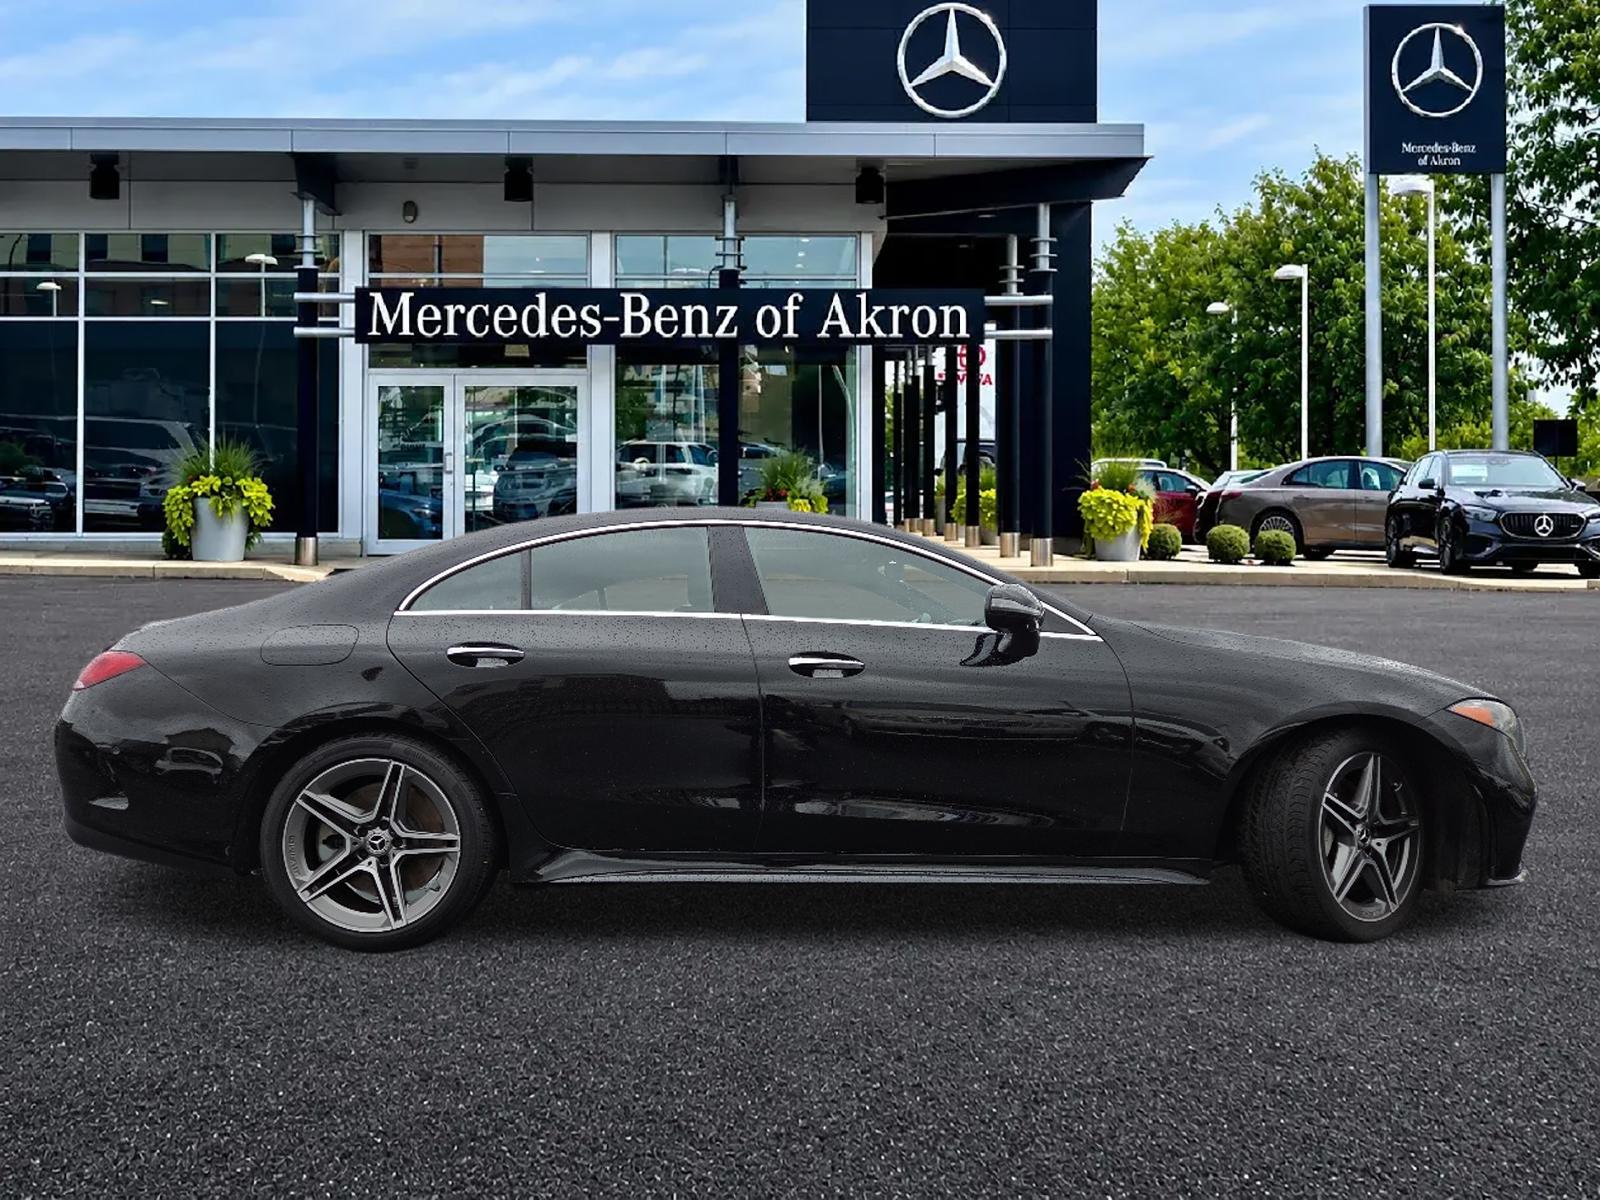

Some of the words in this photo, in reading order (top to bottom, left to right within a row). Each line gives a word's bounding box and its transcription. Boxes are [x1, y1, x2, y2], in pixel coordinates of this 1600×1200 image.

[1401, 142, 1477, 154] Mercedes-Benz
[1417, 154, 1428, 166] of
[1430, 154, 1461, 166] Akron
[367, 291, 738, 338] Mercedes-Benz
[755, 292, 804, 338] of
[816, 291, 971, 338] Akron
